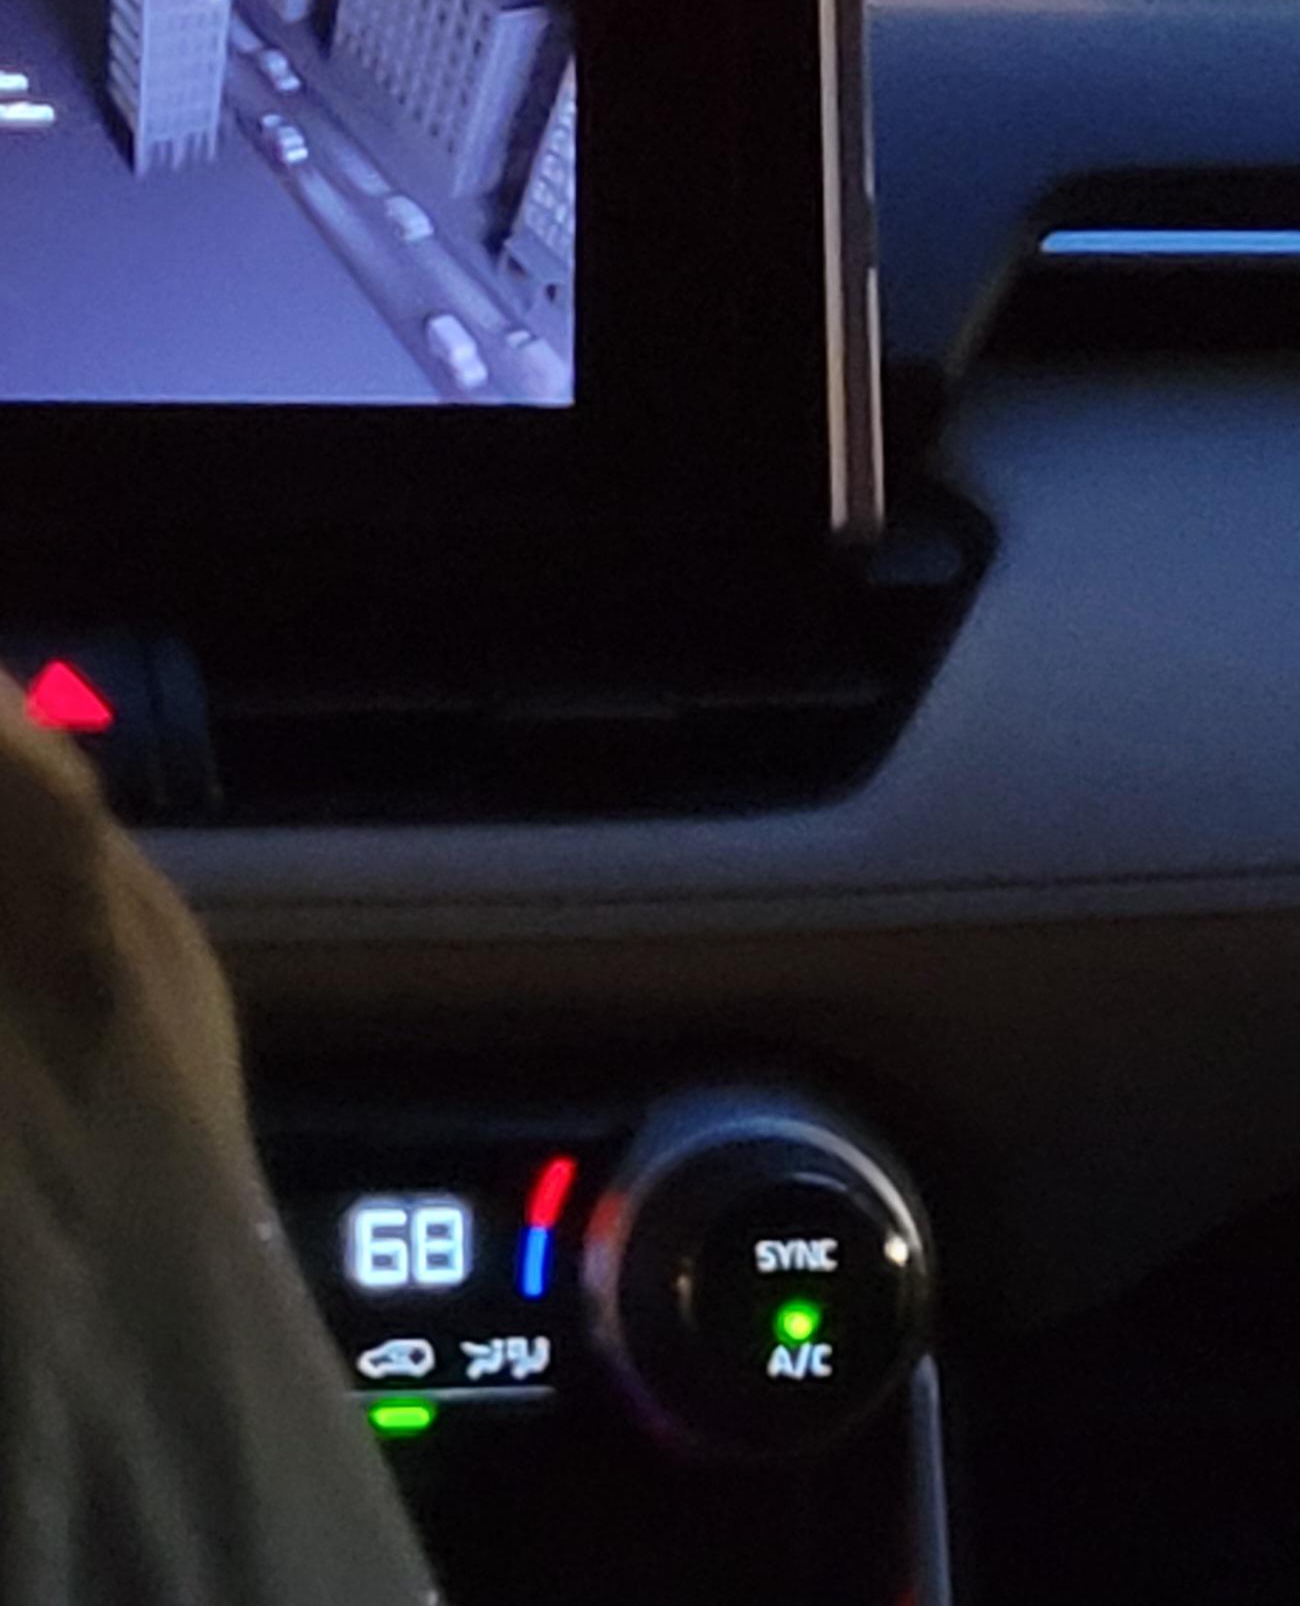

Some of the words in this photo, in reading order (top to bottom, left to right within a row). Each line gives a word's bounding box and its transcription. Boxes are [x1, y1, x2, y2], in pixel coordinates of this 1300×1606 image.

[353, 1206, 466, 1288] 68
[755, 1237, 839, 1273] SYNC
[768, 1342, 833, 1379] A/C
